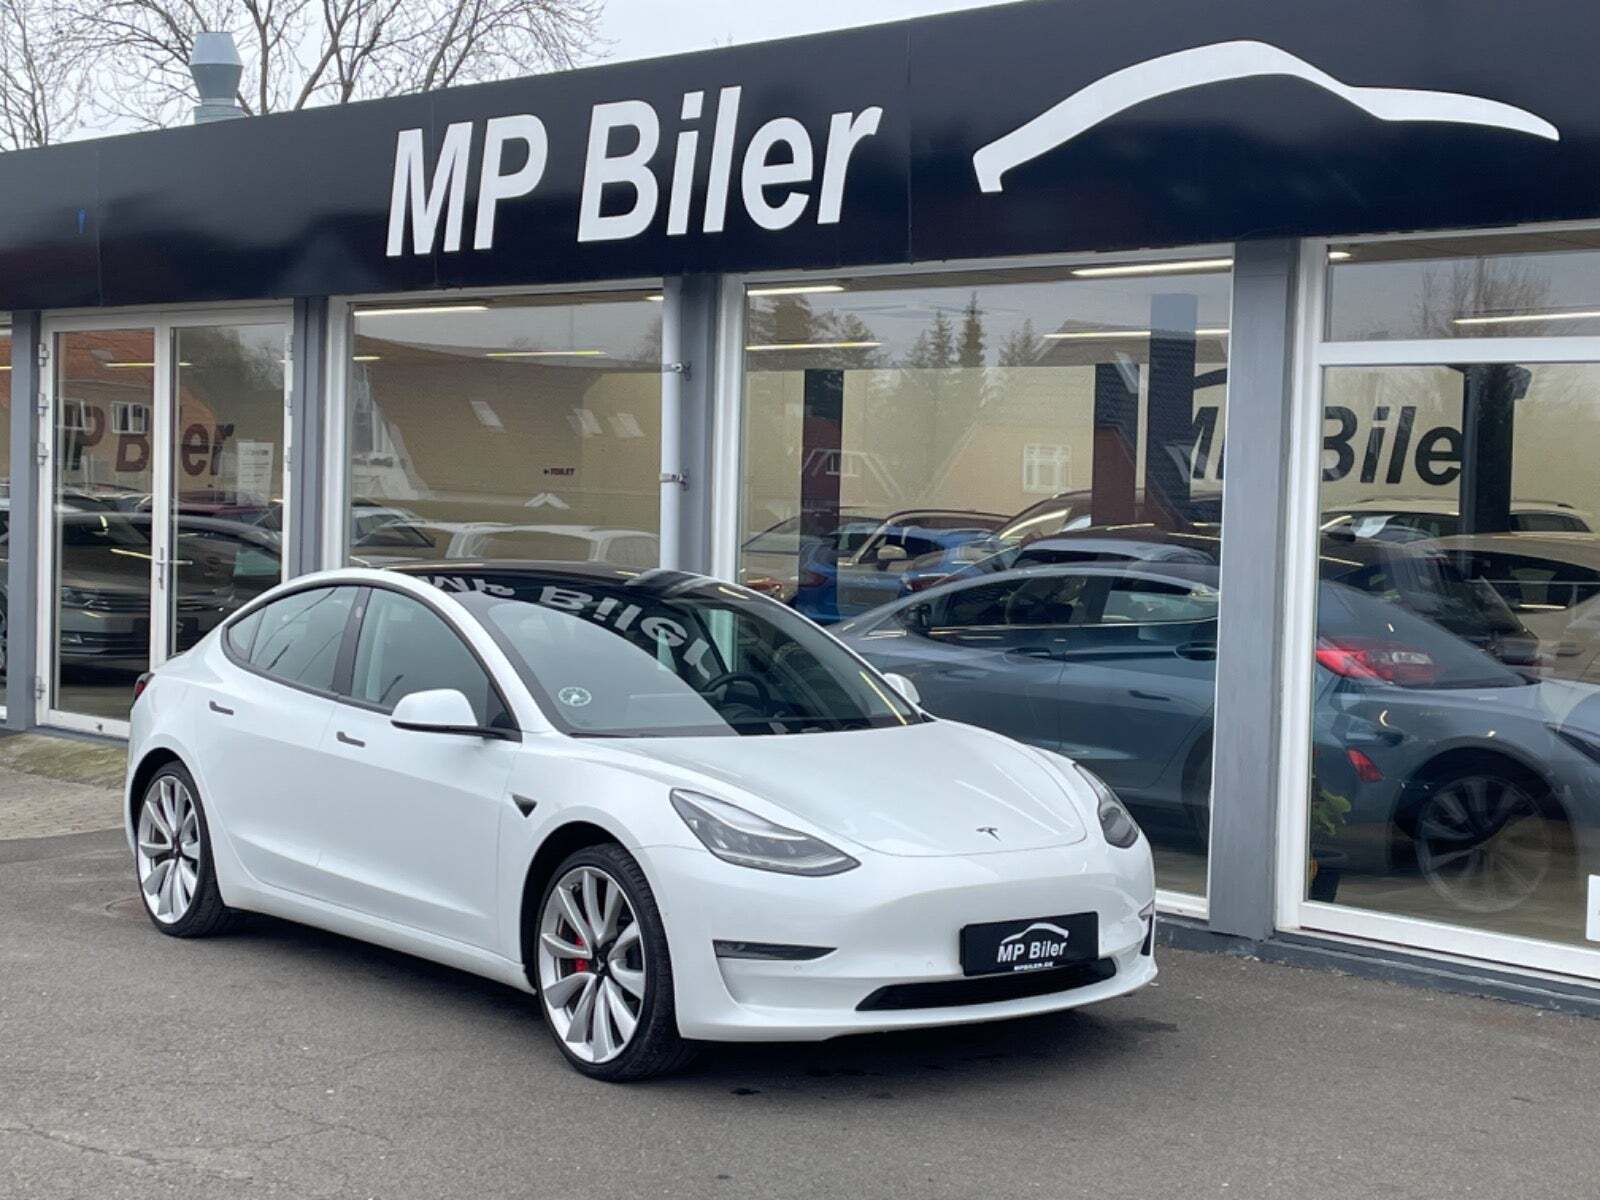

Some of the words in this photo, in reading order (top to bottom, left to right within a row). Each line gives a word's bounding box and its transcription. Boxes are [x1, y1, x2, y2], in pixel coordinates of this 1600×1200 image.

[386, 113, 548, 257] MP
[577, 85, 883, 242] Biler
[1322, 405, 1461, 486] Bile
[998, 944, 1024, 962] MP
[1030, 941, 1067, 959] Biler
